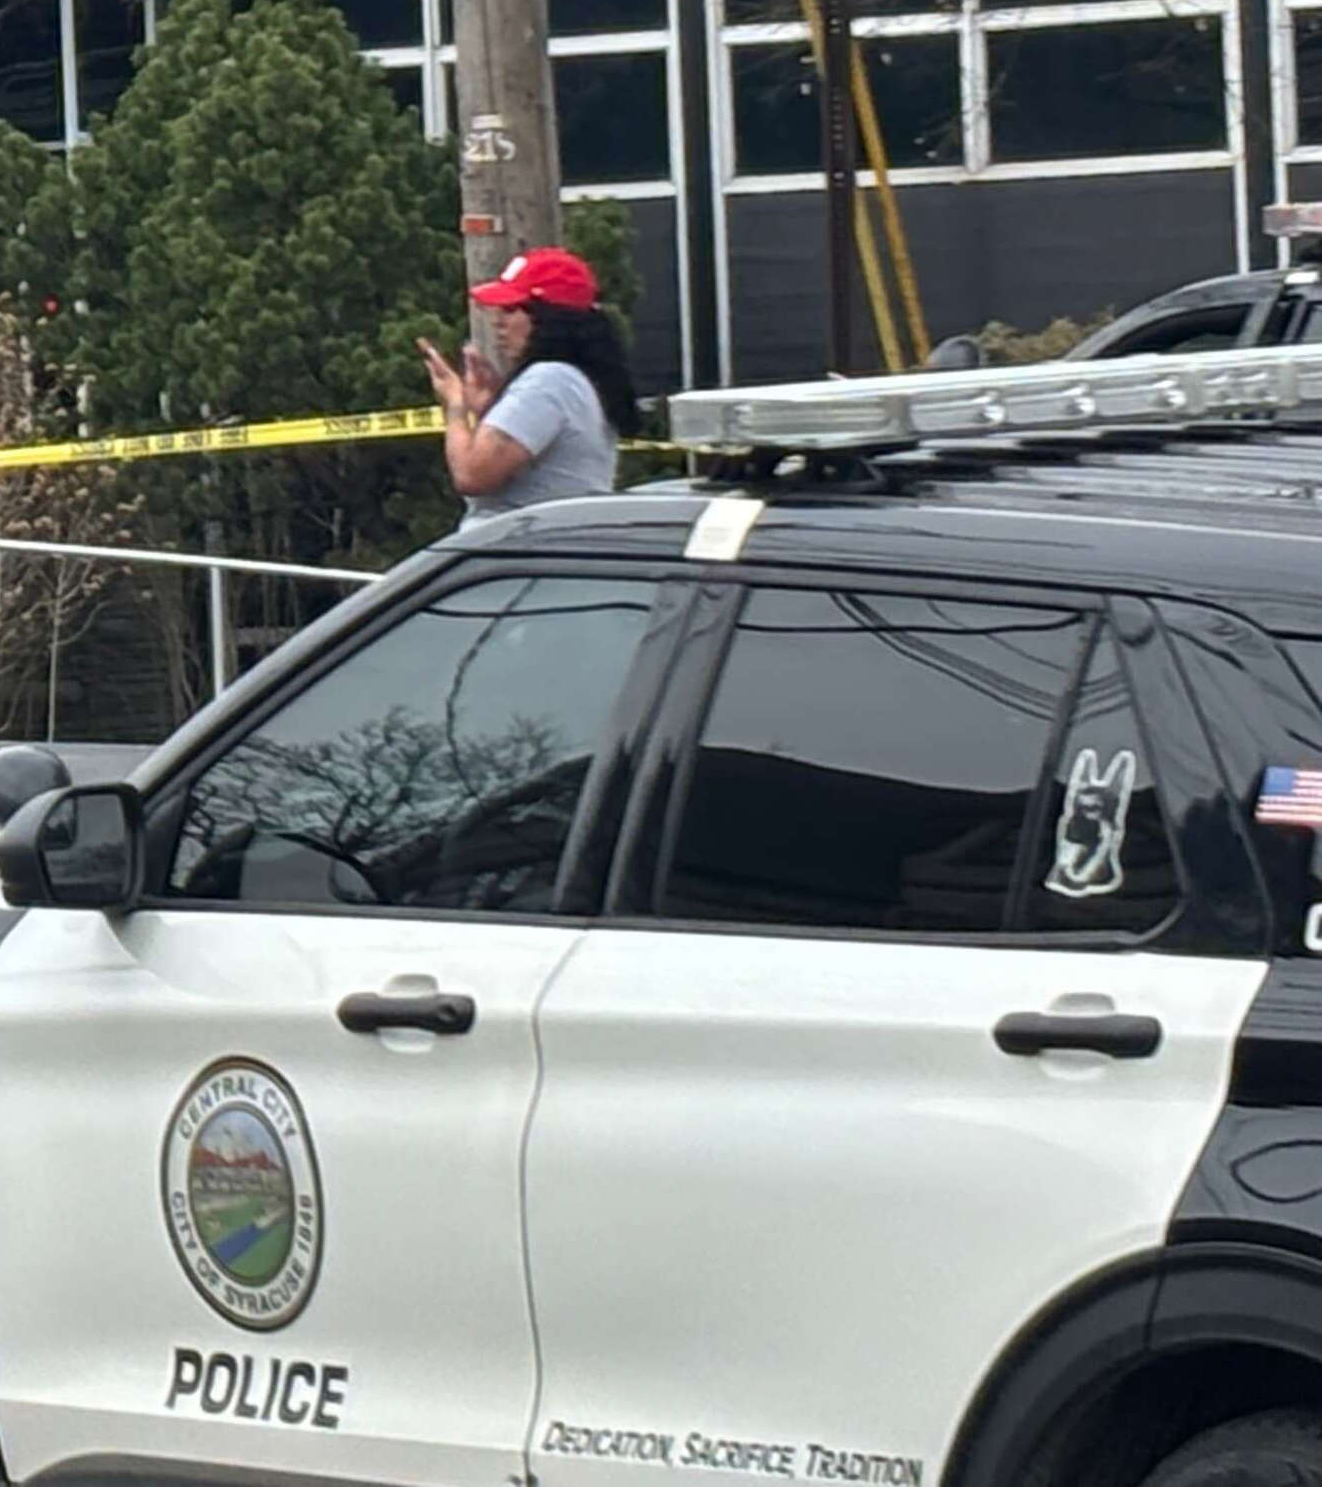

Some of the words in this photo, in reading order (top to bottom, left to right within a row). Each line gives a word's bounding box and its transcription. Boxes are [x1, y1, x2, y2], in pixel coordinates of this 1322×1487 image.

[178, 1075, 258, 1140] CENTRAL
[262, 1087, 296, 1138] CITY
[172, 1191, 197, 1249] CITY
[196, 1256, 221, 1288] OF
[224, 1257, 306, 1313] SYRACUSE
[164, 1347, 349, 1430] POLICE
[806, 1443, 925, 1487] TRADITION
